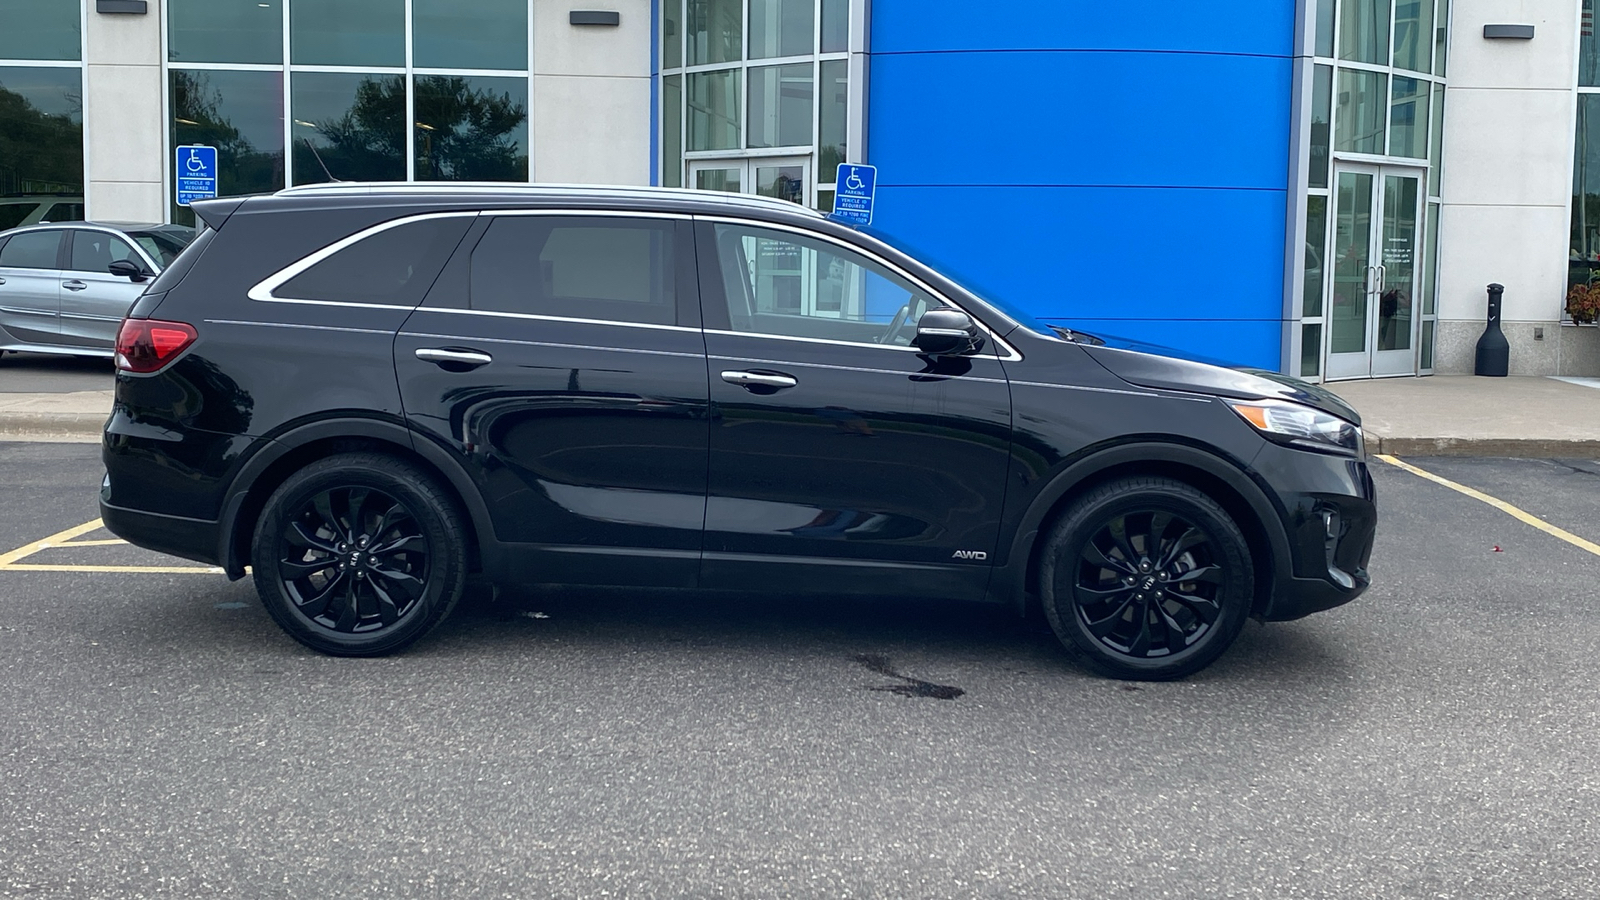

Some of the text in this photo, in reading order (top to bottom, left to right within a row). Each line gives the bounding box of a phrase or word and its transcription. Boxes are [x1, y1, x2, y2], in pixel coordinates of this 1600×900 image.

[350, 552, 360, 566] KIA
[951, 550, 987, 560] AWD
[1142, 578, 1155, 590] KIA
